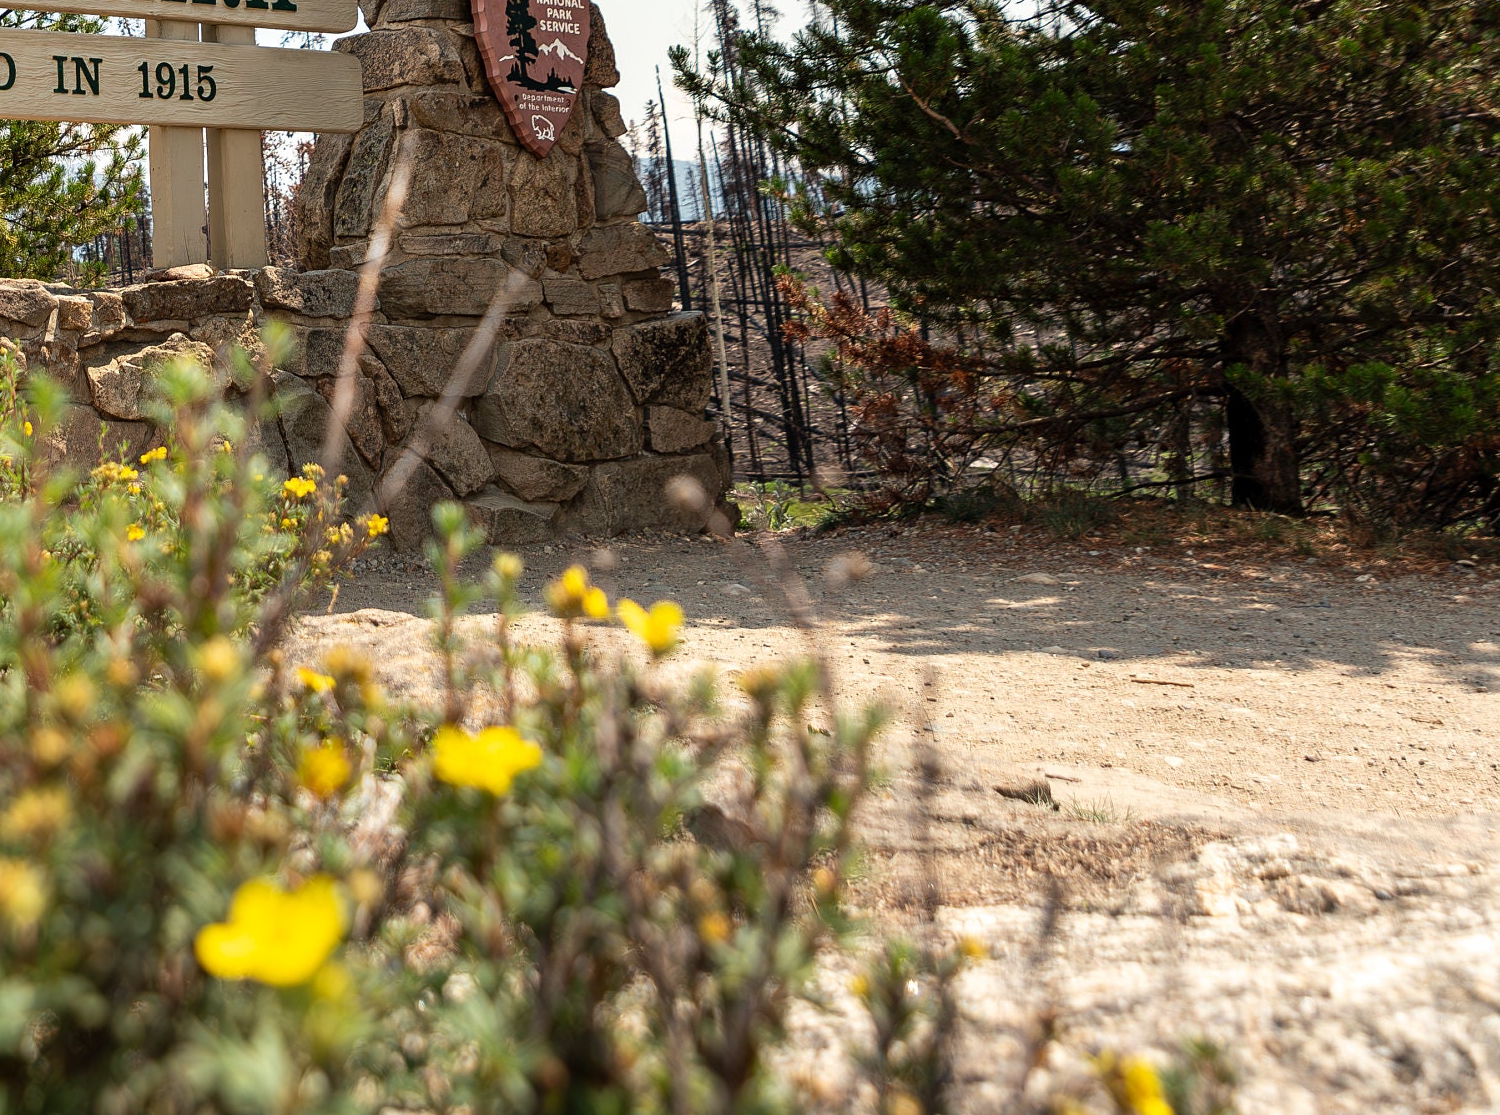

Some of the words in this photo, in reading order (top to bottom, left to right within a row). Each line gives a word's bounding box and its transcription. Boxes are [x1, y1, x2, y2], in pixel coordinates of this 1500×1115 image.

[546, 7, 573, 21] PARK
[540, 20, 581, 35] SERVICE
[52, 56, 103, 97] IN
[137, 61, 217, 102] 1915
[522, 93, 565, 104] Department
[519, 102, 527, 110] of
[528, 103, 540, 111] the
